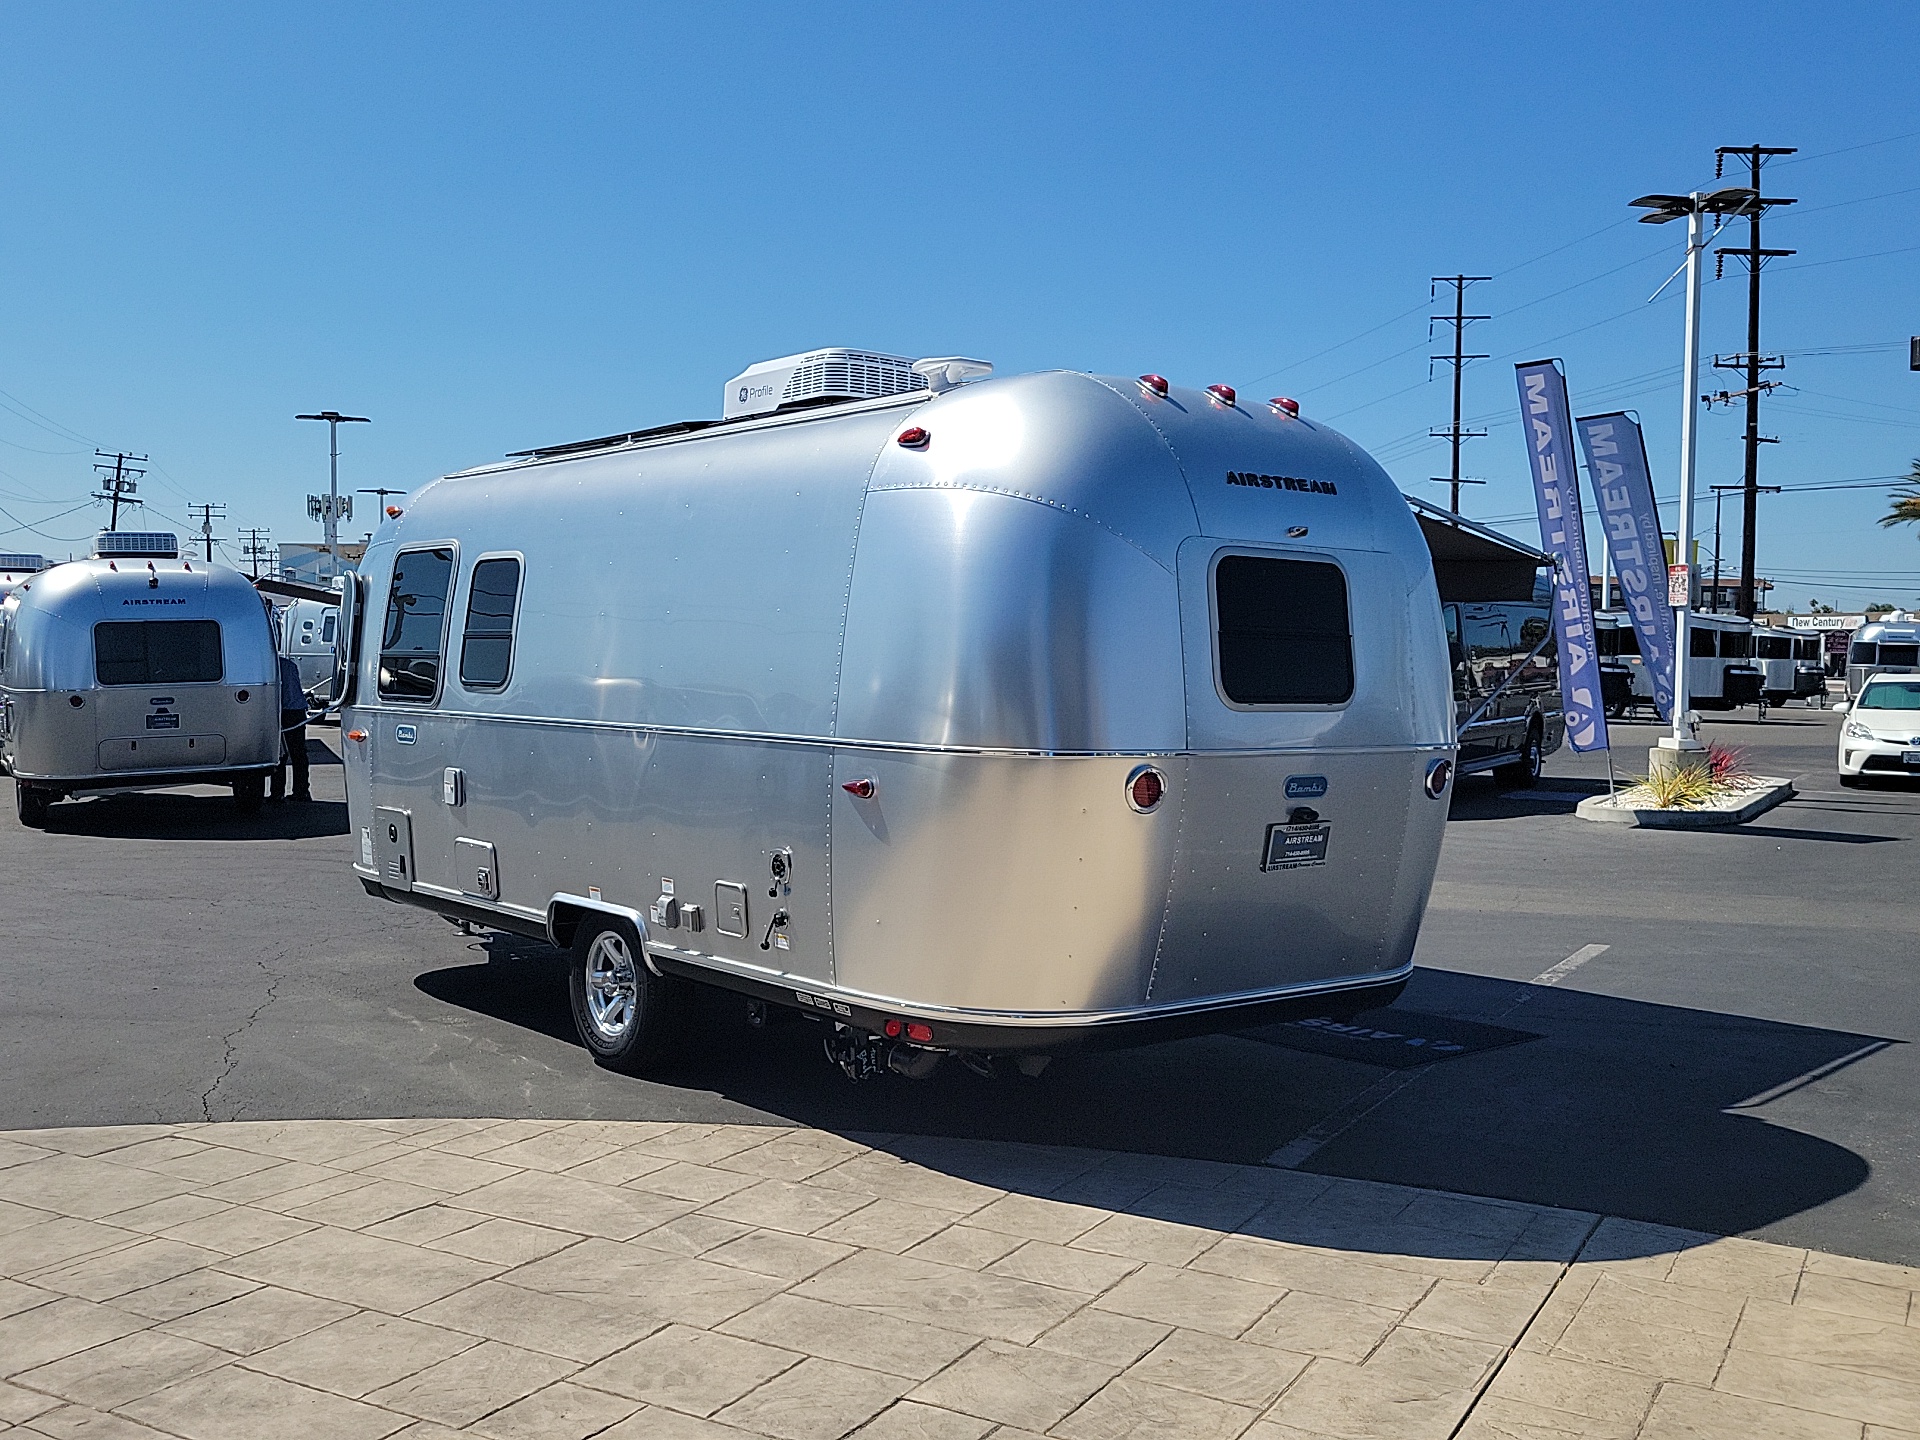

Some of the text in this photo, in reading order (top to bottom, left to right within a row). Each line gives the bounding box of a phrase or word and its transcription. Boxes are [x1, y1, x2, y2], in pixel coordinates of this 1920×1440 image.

[750, 385, 773, 398] Profile
[1226, 471, 1338, 496] AIRSTREAM
[122, 598, 187, 606] AIRSTREAM
[1812, 616, 1846, 629] Century
[1288, 782, 1324, 793] Bambi
[1285, 835, 1323, 844] AIRSTREAM
